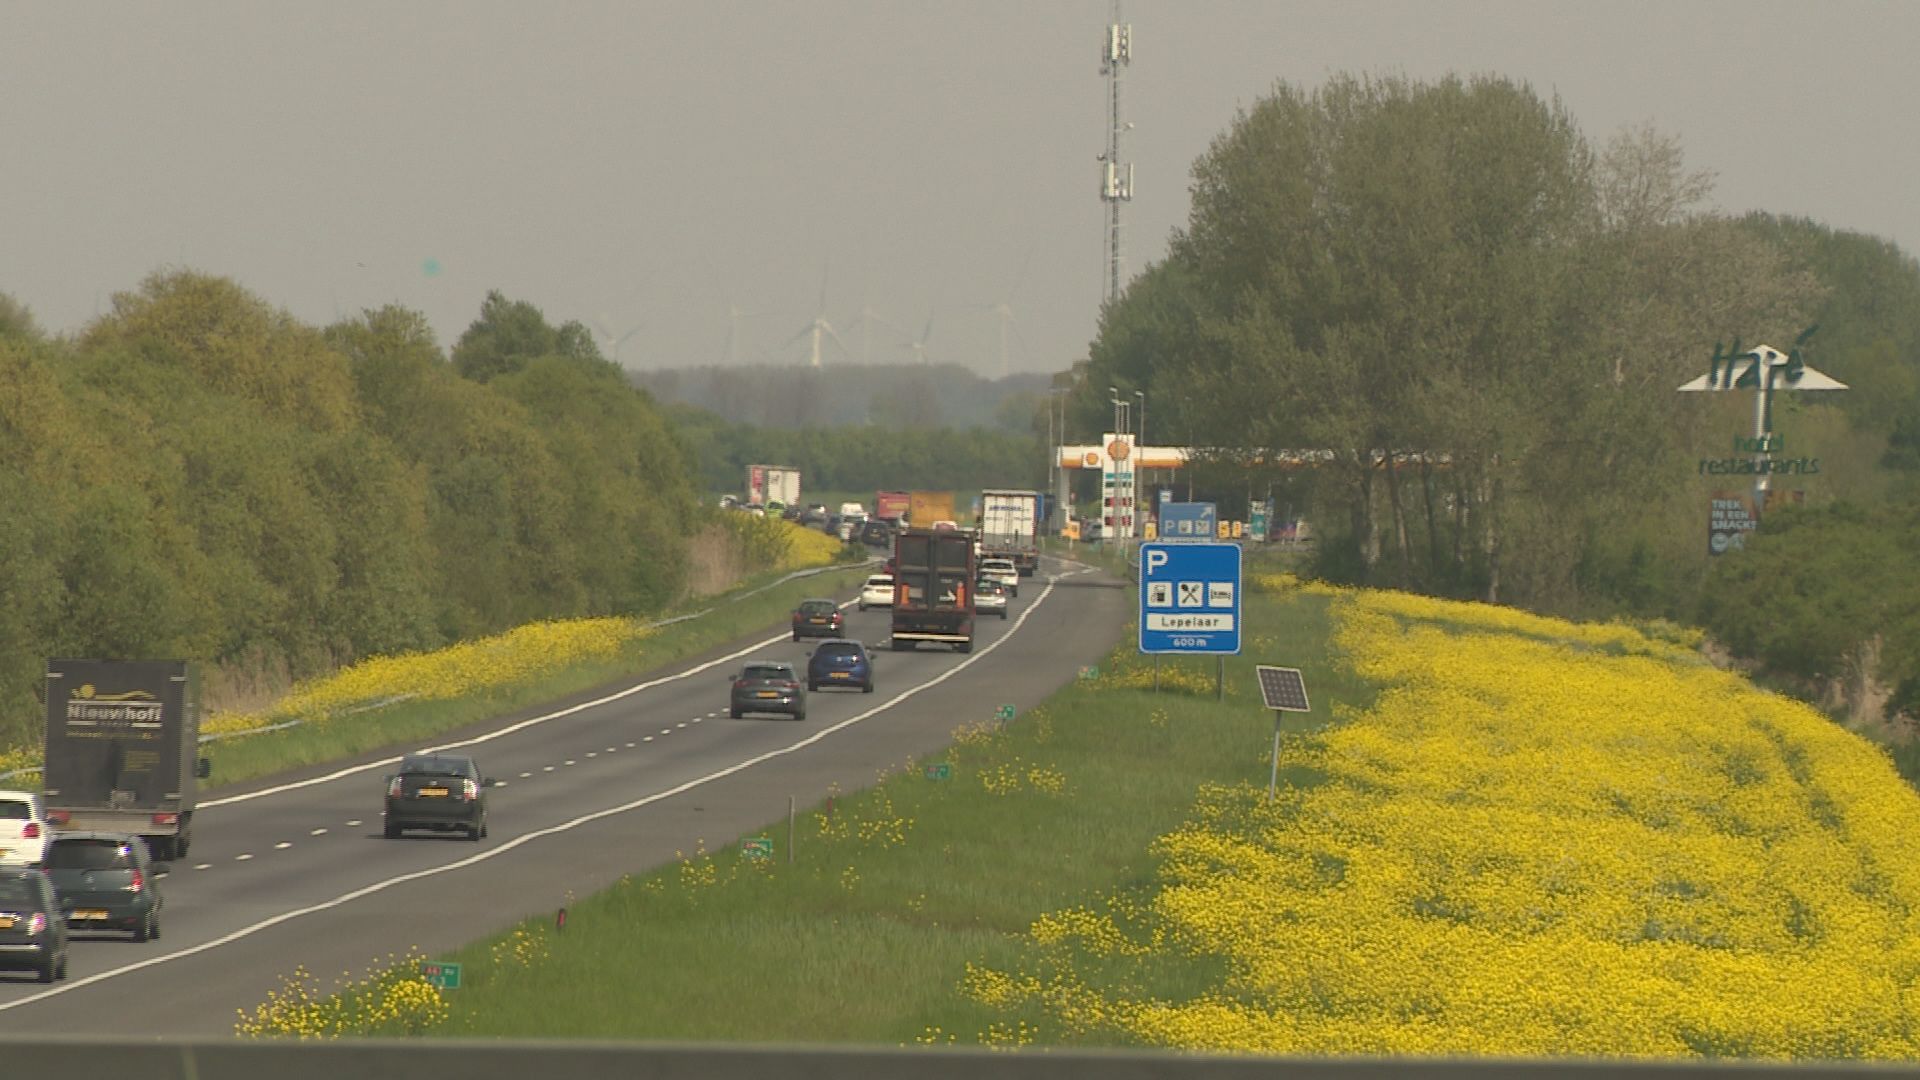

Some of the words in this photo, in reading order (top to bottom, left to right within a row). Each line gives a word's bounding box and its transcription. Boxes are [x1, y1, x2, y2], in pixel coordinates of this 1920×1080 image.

[1733, 433, 1784, 452] hotel
[1700, 456, 1819, 475] restaurants
[1147, 550, 1169, 576] P
[1161, 616, 1219, 631] Lepelaar
[1173, 638, 1195, 647] 600
[1196, 639, 1207, 647] m
